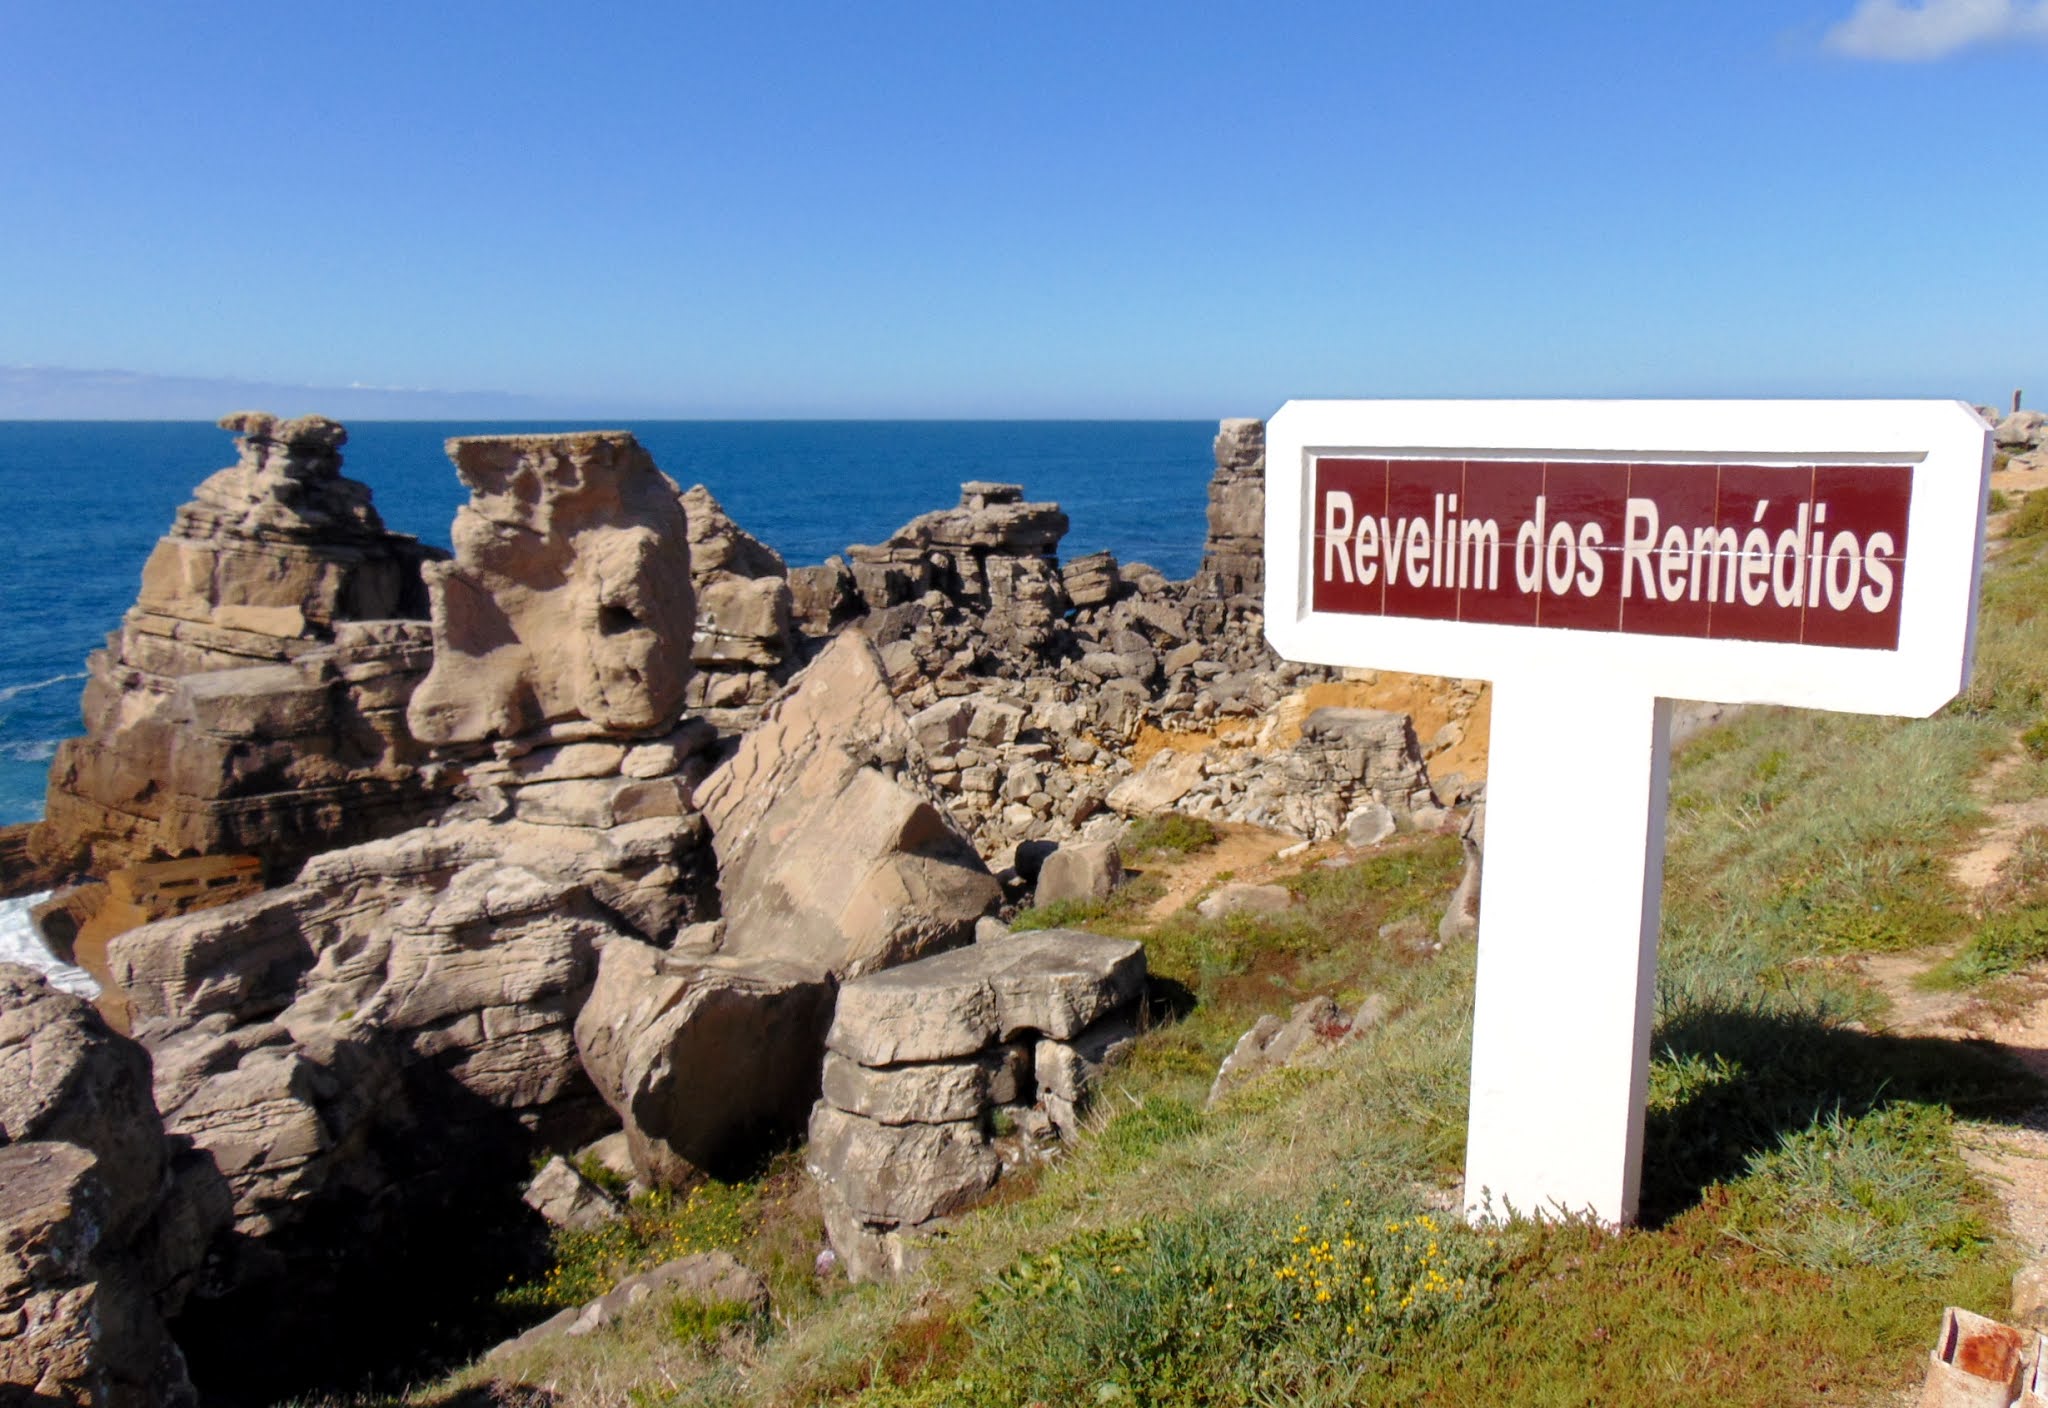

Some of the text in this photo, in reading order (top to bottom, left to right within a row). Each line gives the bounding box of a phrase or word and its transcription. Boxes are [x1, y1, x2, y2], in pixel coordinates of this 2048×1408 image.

[1324, 490, 1895, 613] Revelim dos Remédios
